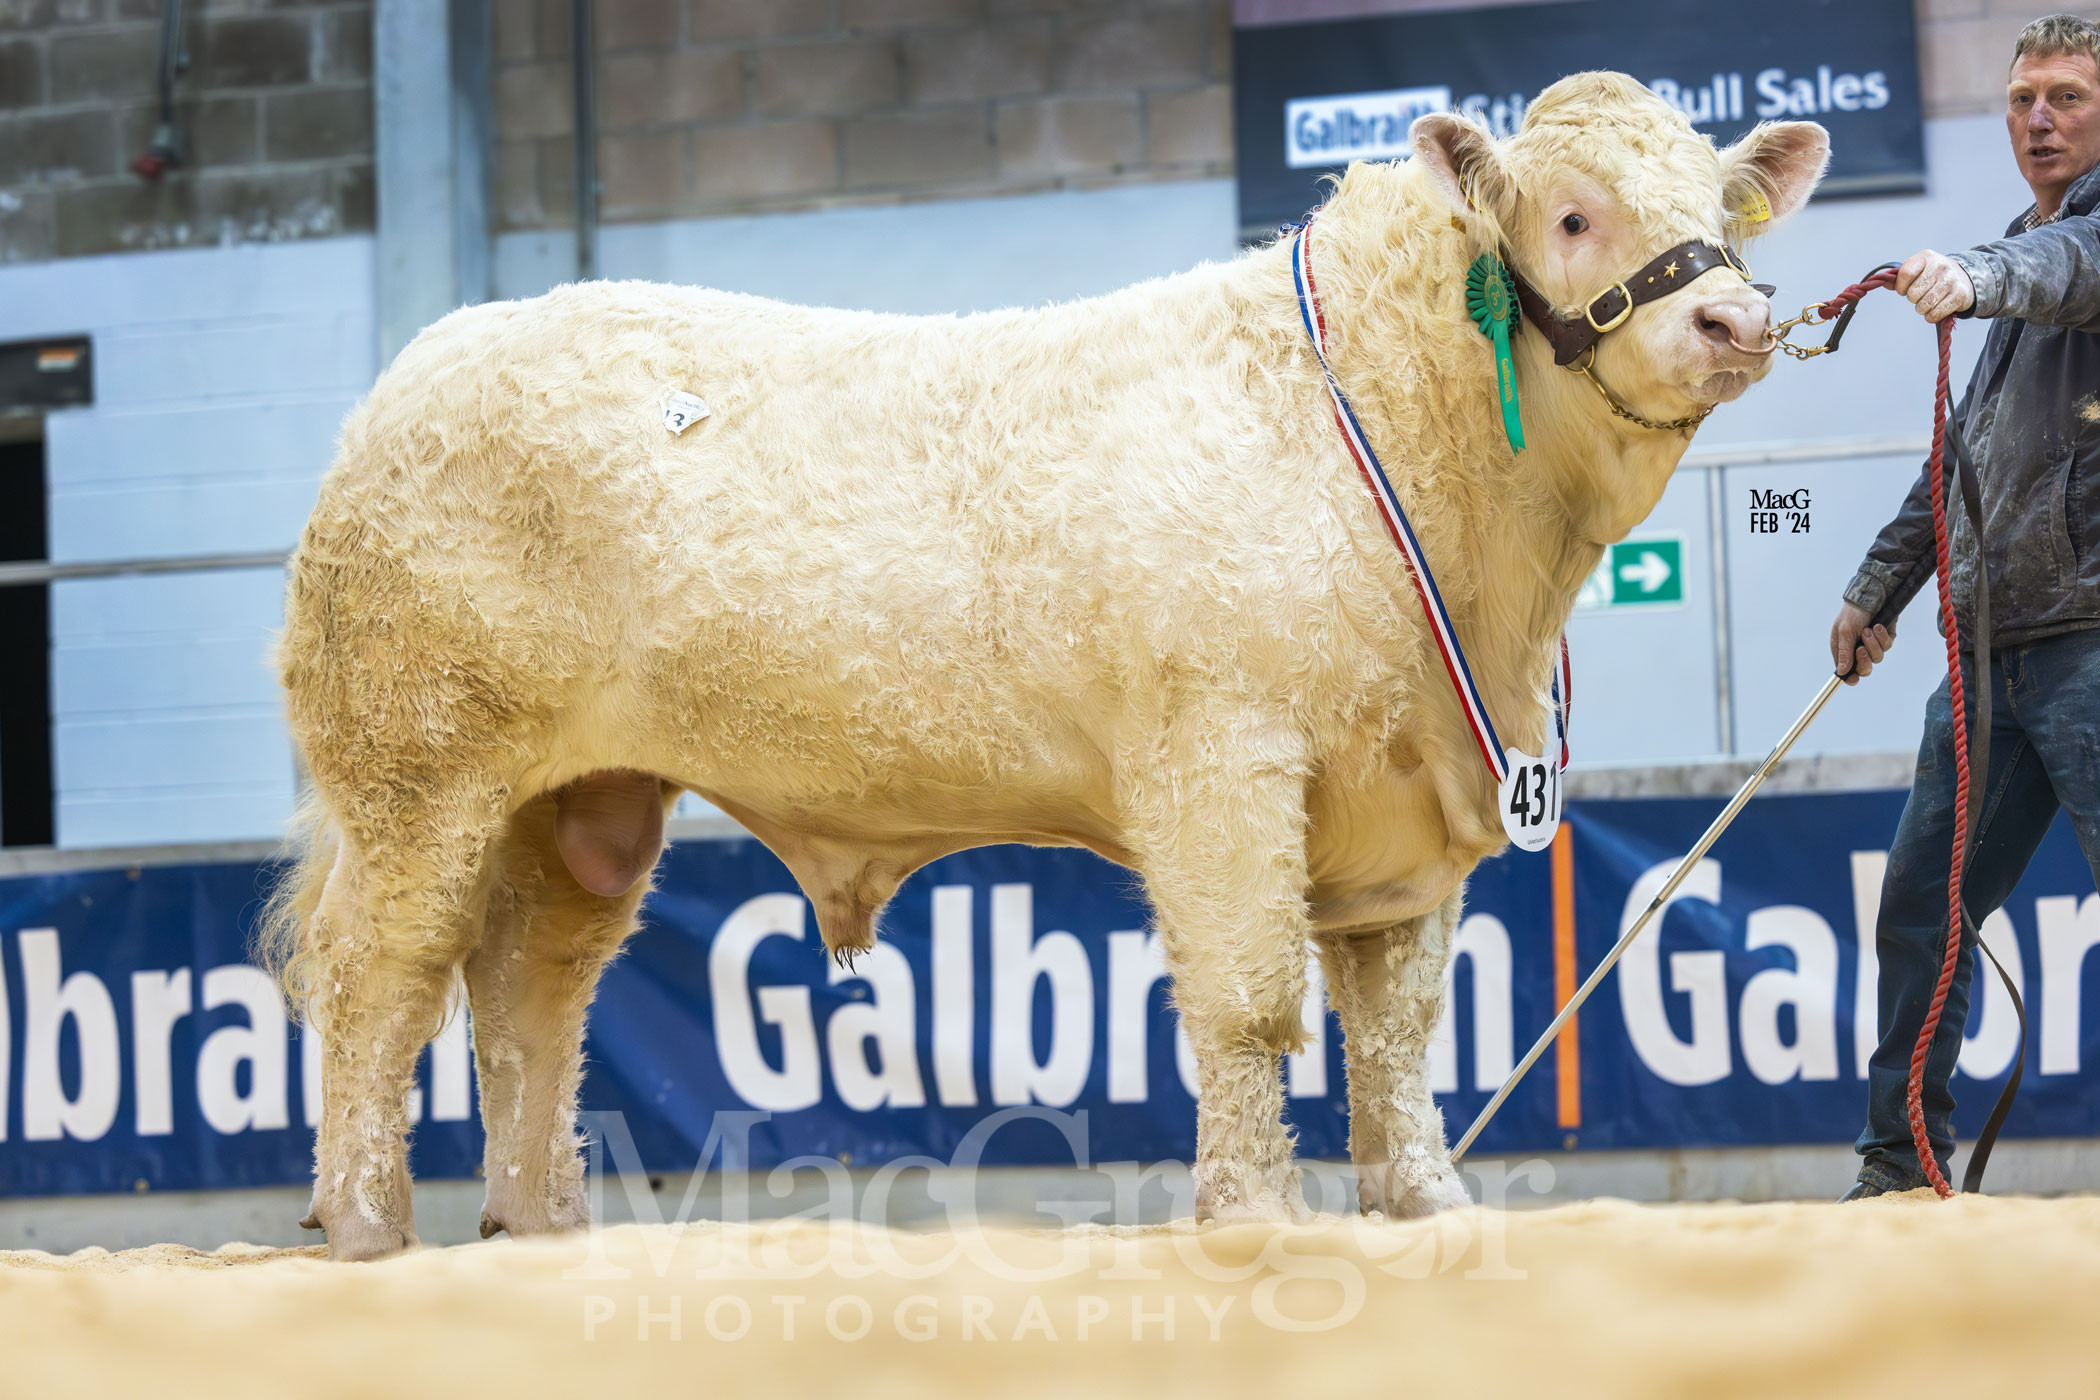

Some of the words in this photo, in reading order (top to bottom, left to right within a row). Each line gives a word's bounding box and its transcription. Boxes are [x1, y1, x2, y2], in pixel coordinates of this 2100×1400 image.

[1294, 101, 1433, 154] Galbrai
[1650, 72, 1743, 124] Bull
[1756, 65, 1890, 118] Sales
[1510, 761, 1557, 827] 431
